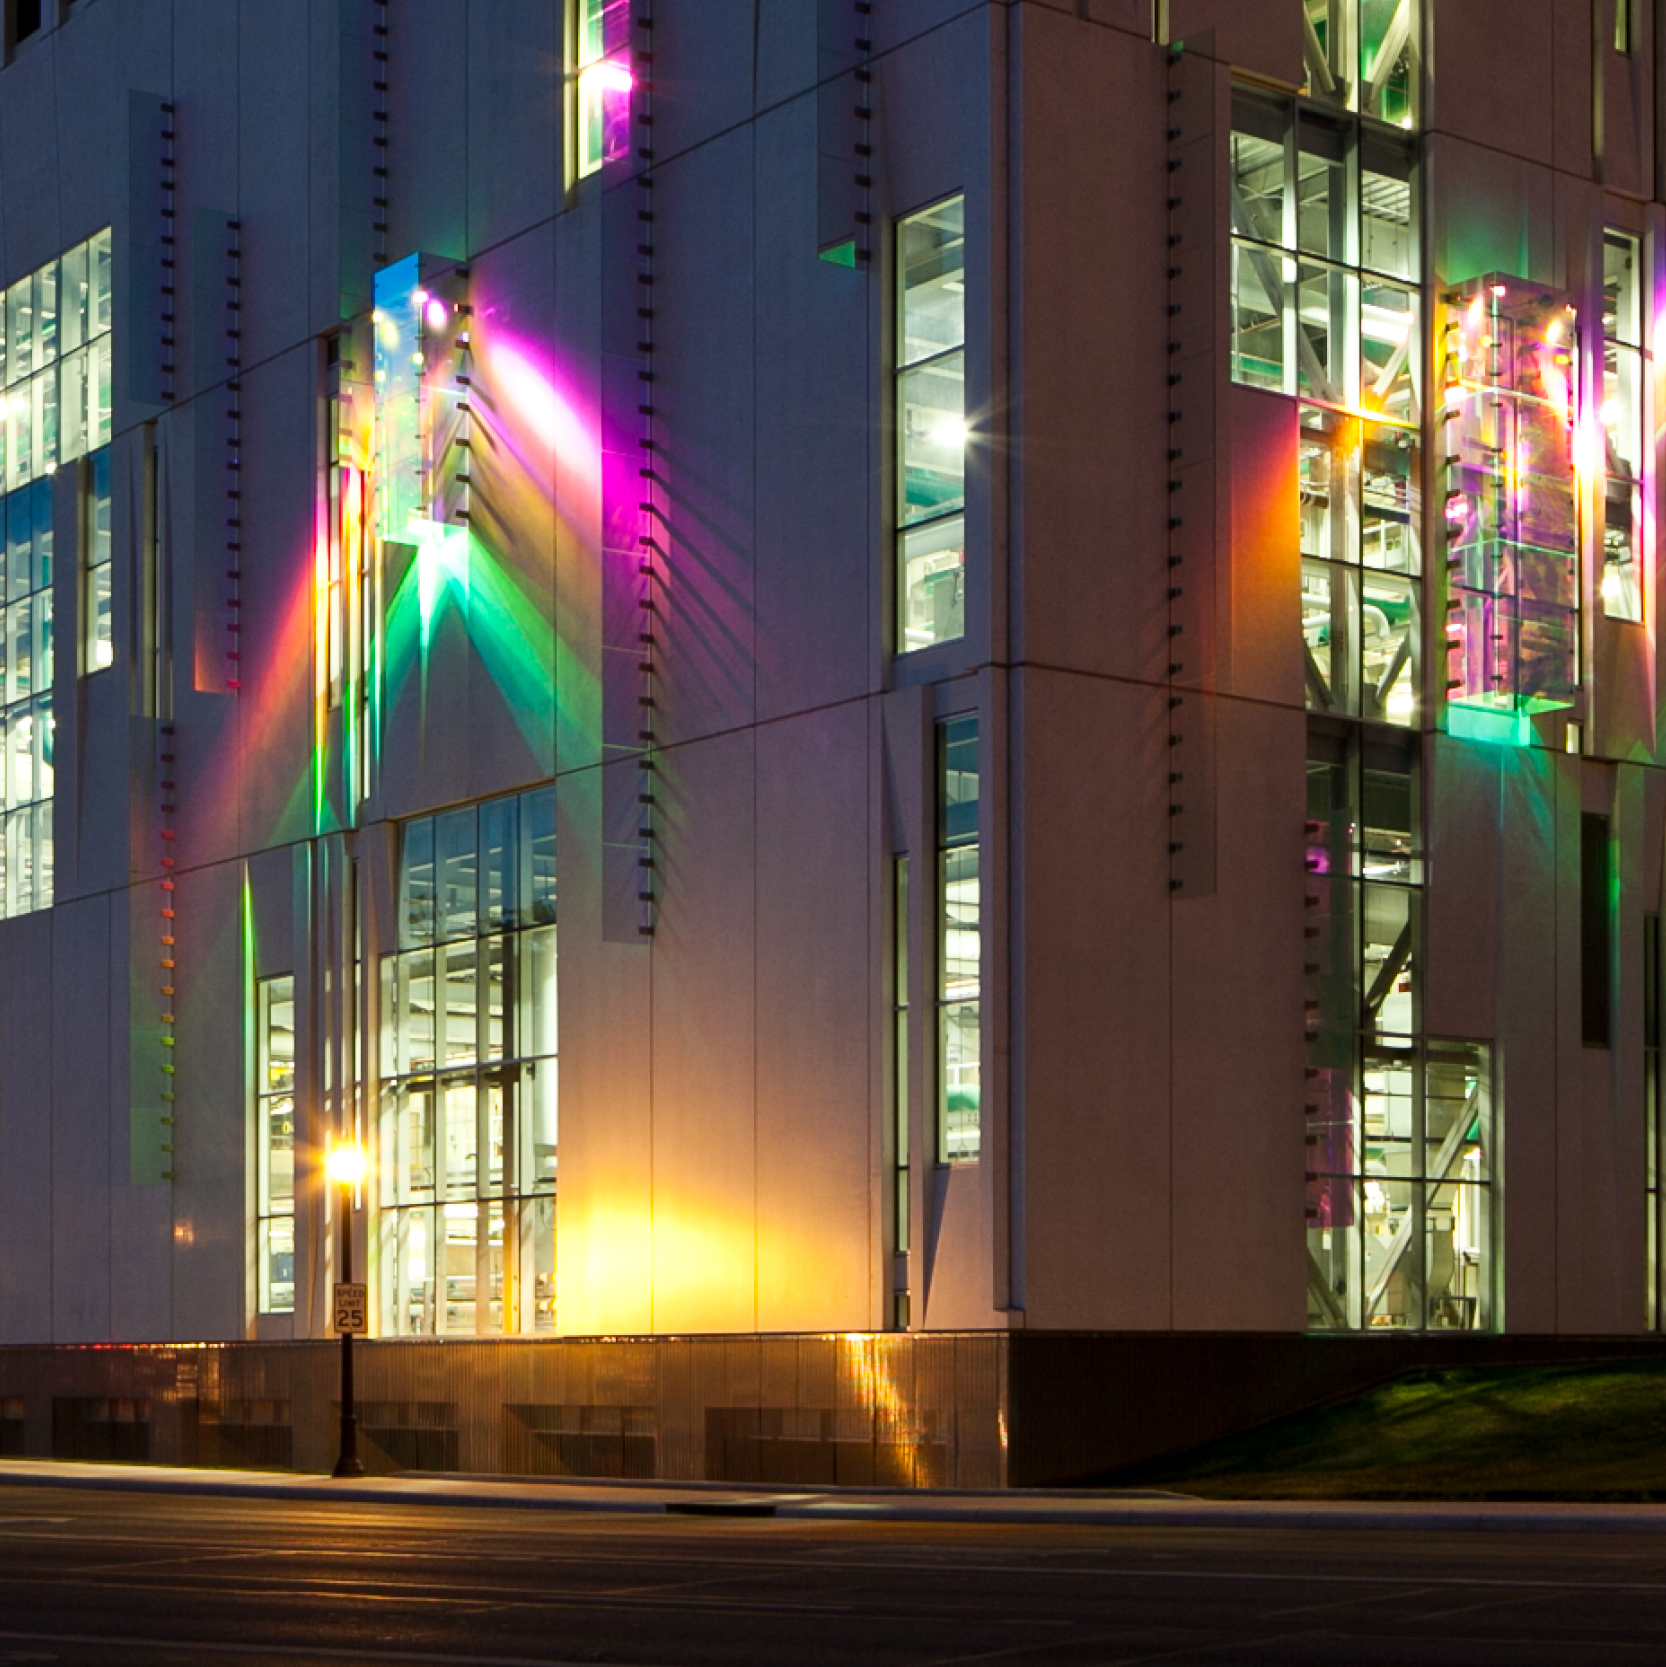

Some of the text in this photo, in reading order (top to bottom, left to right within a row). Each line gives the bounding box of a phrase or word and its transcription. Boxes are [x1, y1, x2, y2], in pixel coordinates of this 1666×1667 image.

[337, 1288, 364, 1297] SPEED
[338, 1298, 361, 1307] LIMIT
[337, 1309, 363, 1326] 25
